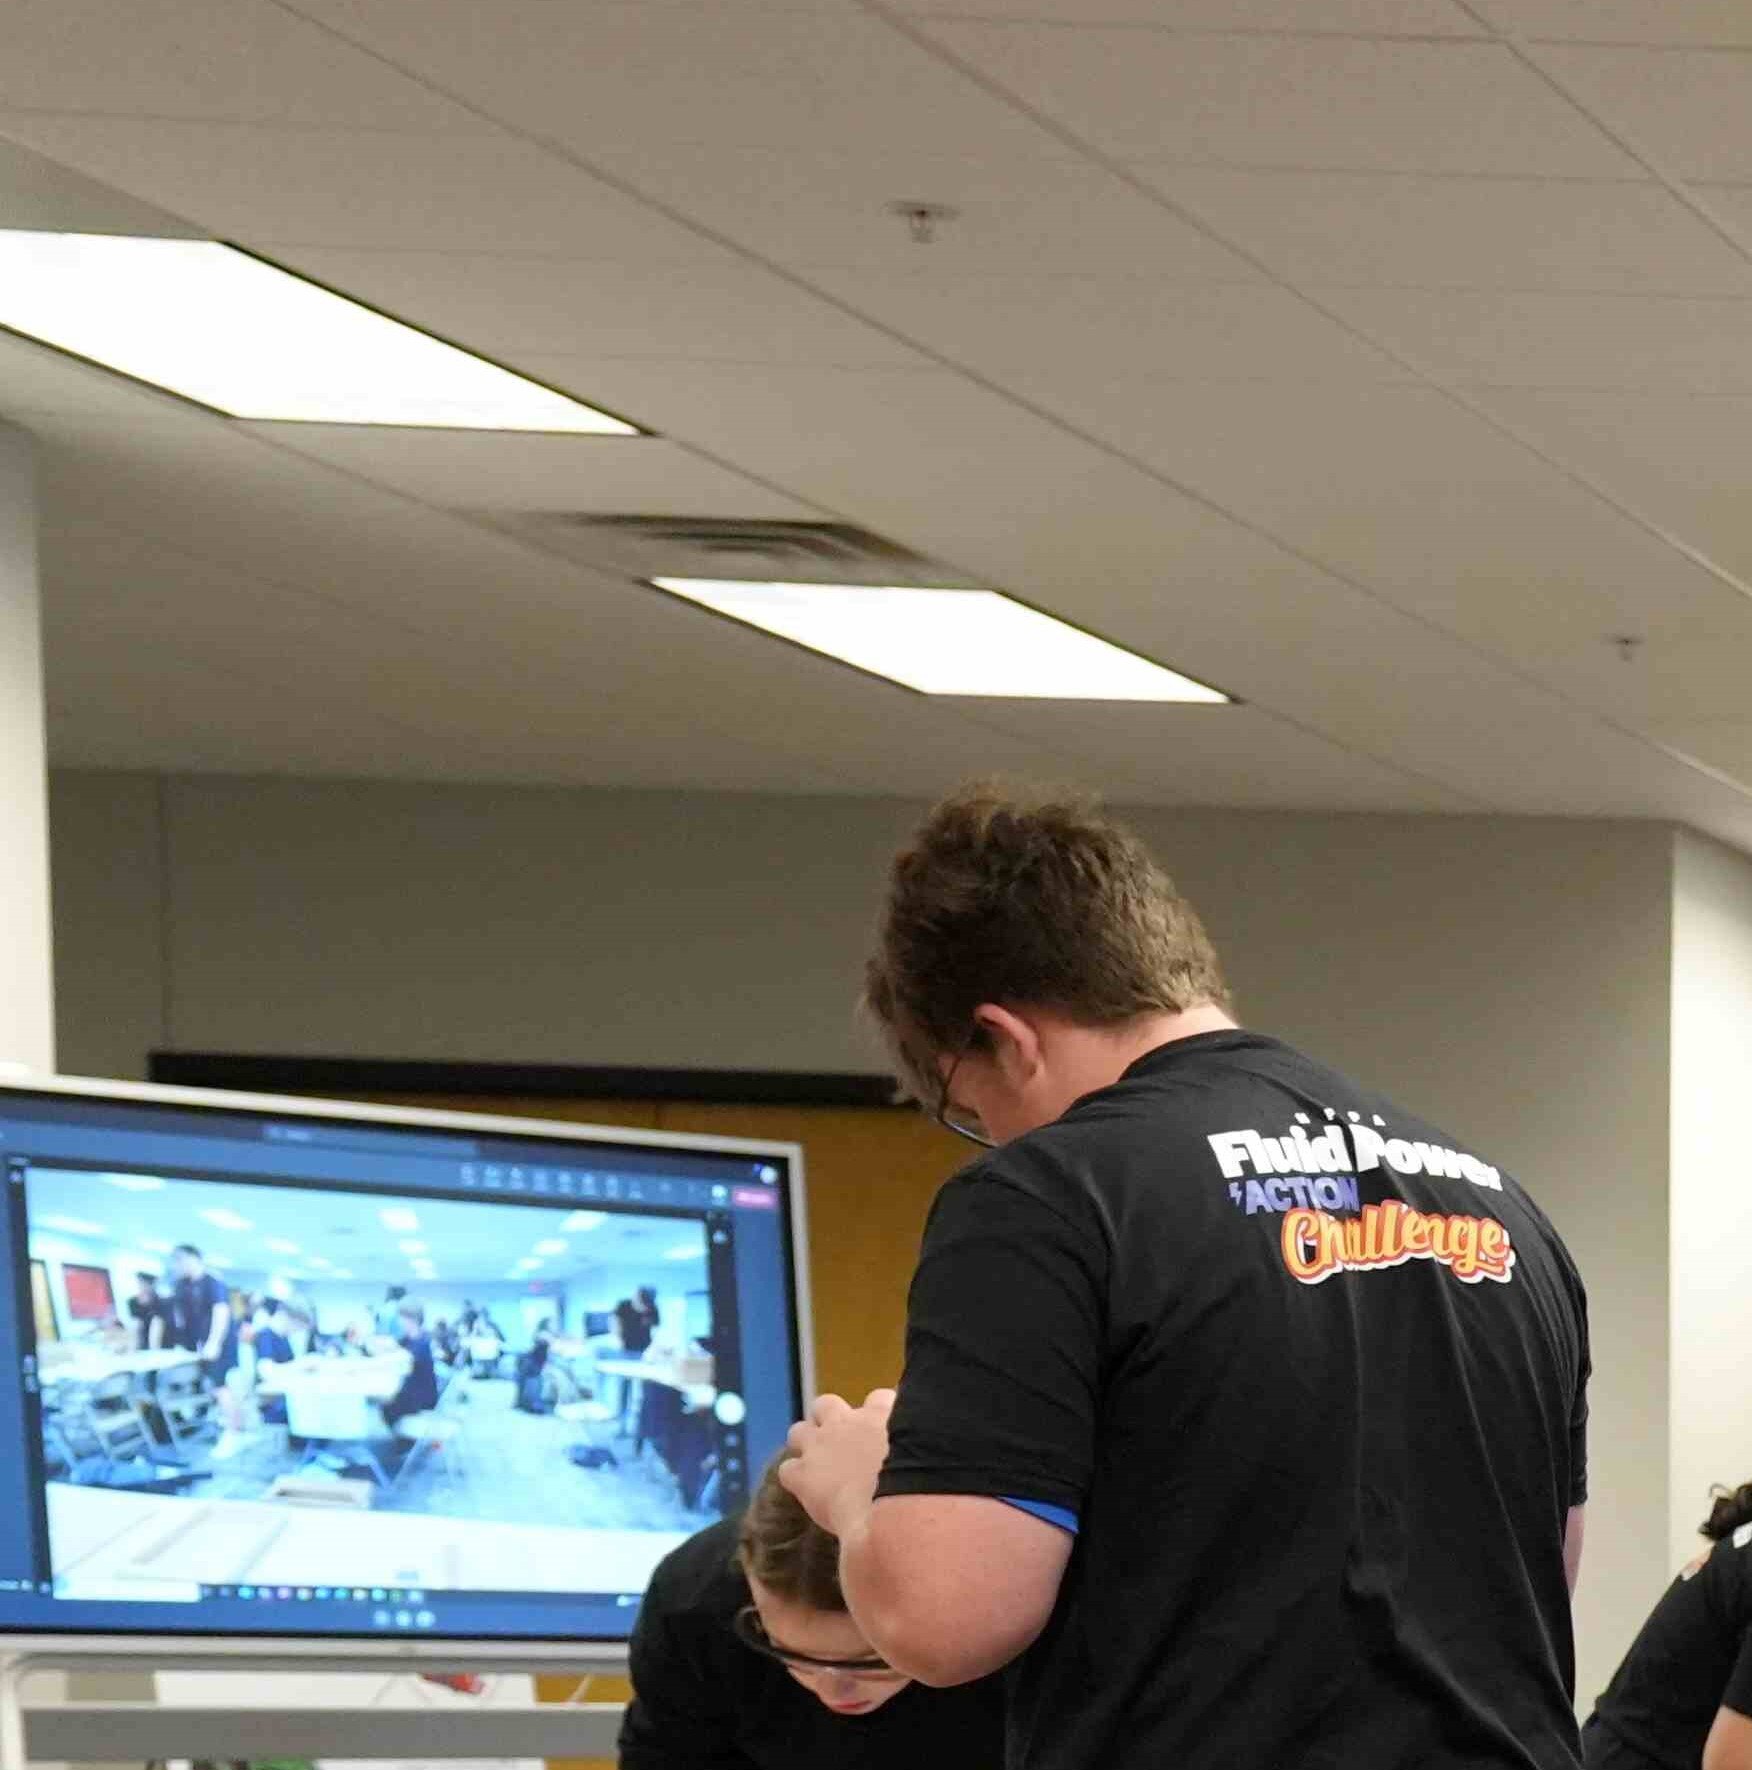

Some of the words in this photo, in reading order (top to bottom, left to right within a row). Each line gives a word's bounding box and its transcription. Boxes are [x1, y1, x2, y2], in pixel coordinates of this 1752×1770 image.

[1207, 1124, 1352, 1179] Fluid
[1349, 1124, 1504, 1191] Power
[1244, 1176, 1360, 1215] ACTION
[1281, 1199, 1516, 1285] Challenge
